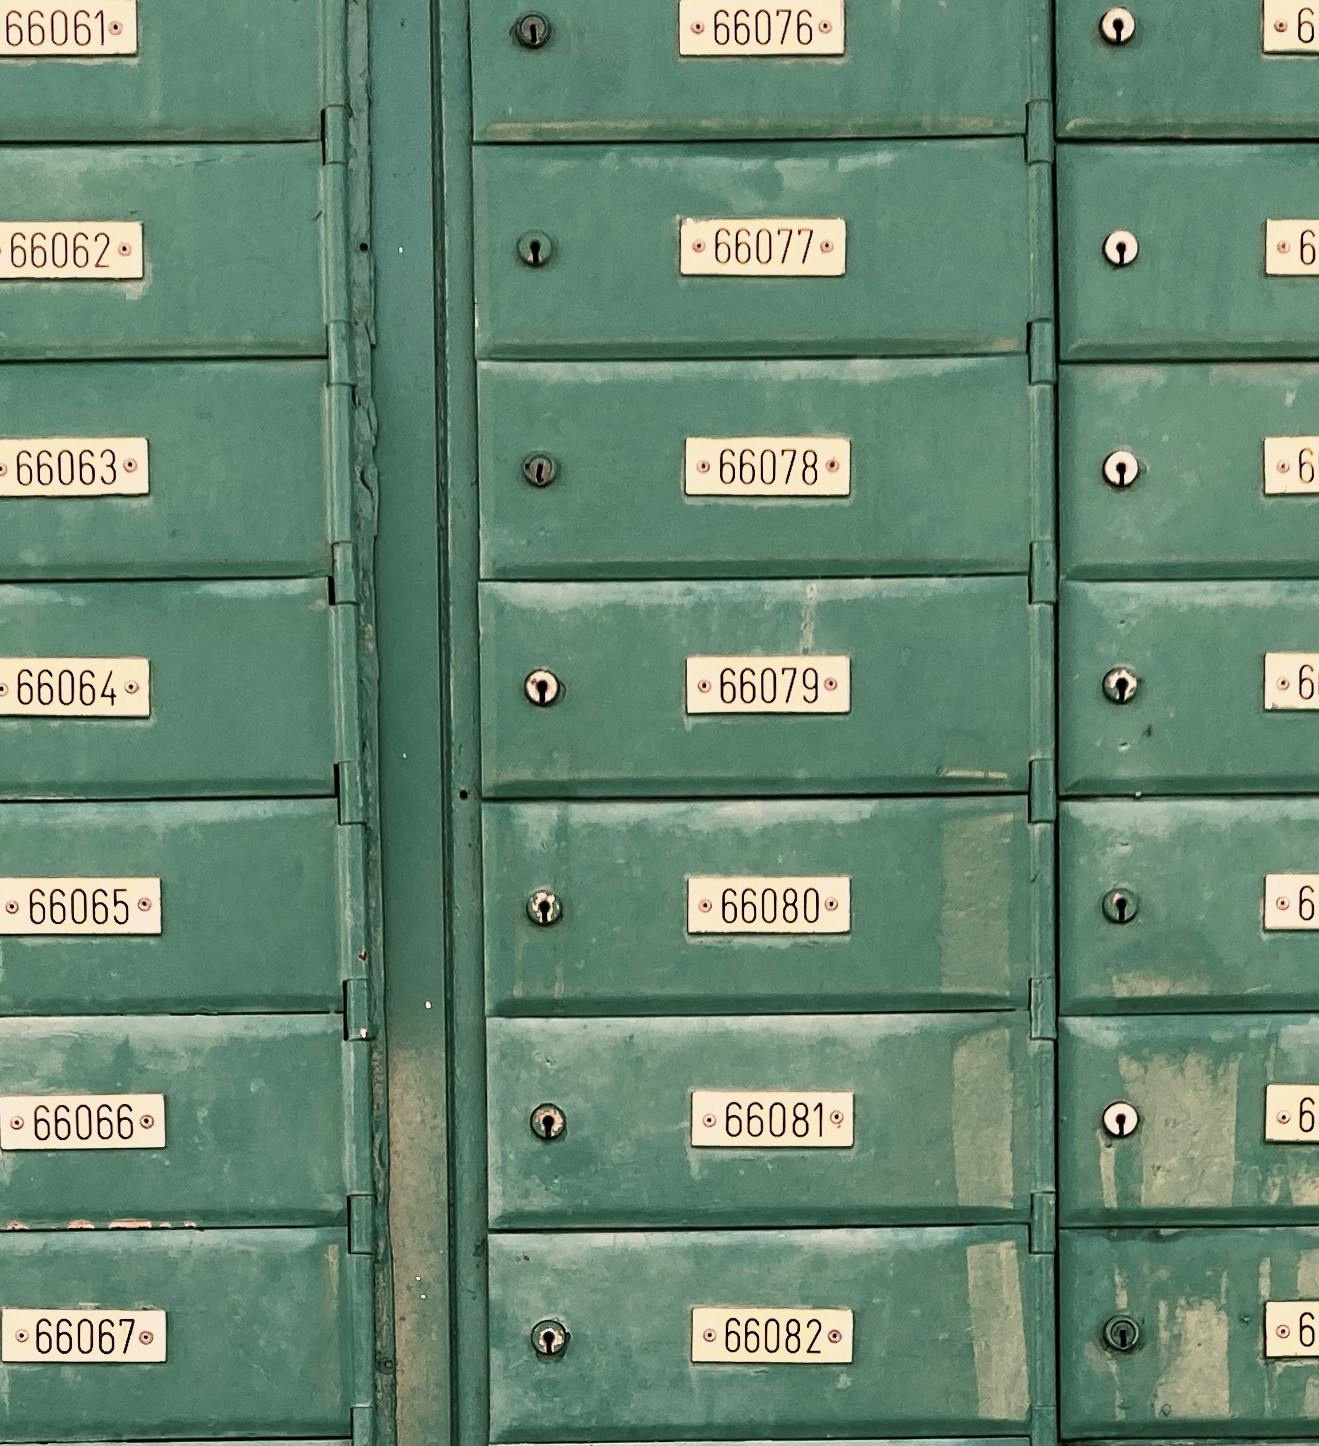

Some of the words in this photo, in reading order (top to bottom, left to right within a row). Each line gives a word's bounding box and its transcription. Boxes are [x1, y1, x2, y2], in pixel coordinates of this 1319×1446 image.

[5, 9, 105, 47] 66061
[713, 8, 813, 46] 66076
[10, 231, 110, 269] 66062
[714, 227, 814, 265] 66077
[16, 448, 117, 487] 66063
[719, 448, 818, 486] 66078
[17, 668, 117, 707] 66064
[719, 666, 819, 705] 66079
[29, 888, 130, 926] 66065
[721, 887, 820, 924] 66080
[33, 1103, 134, 1142] 66066
[725, 1101, 823, 1138] 66081
[35, 1317, 136, 1355] 66067
[724, 1317, 822, 1355] 66082
